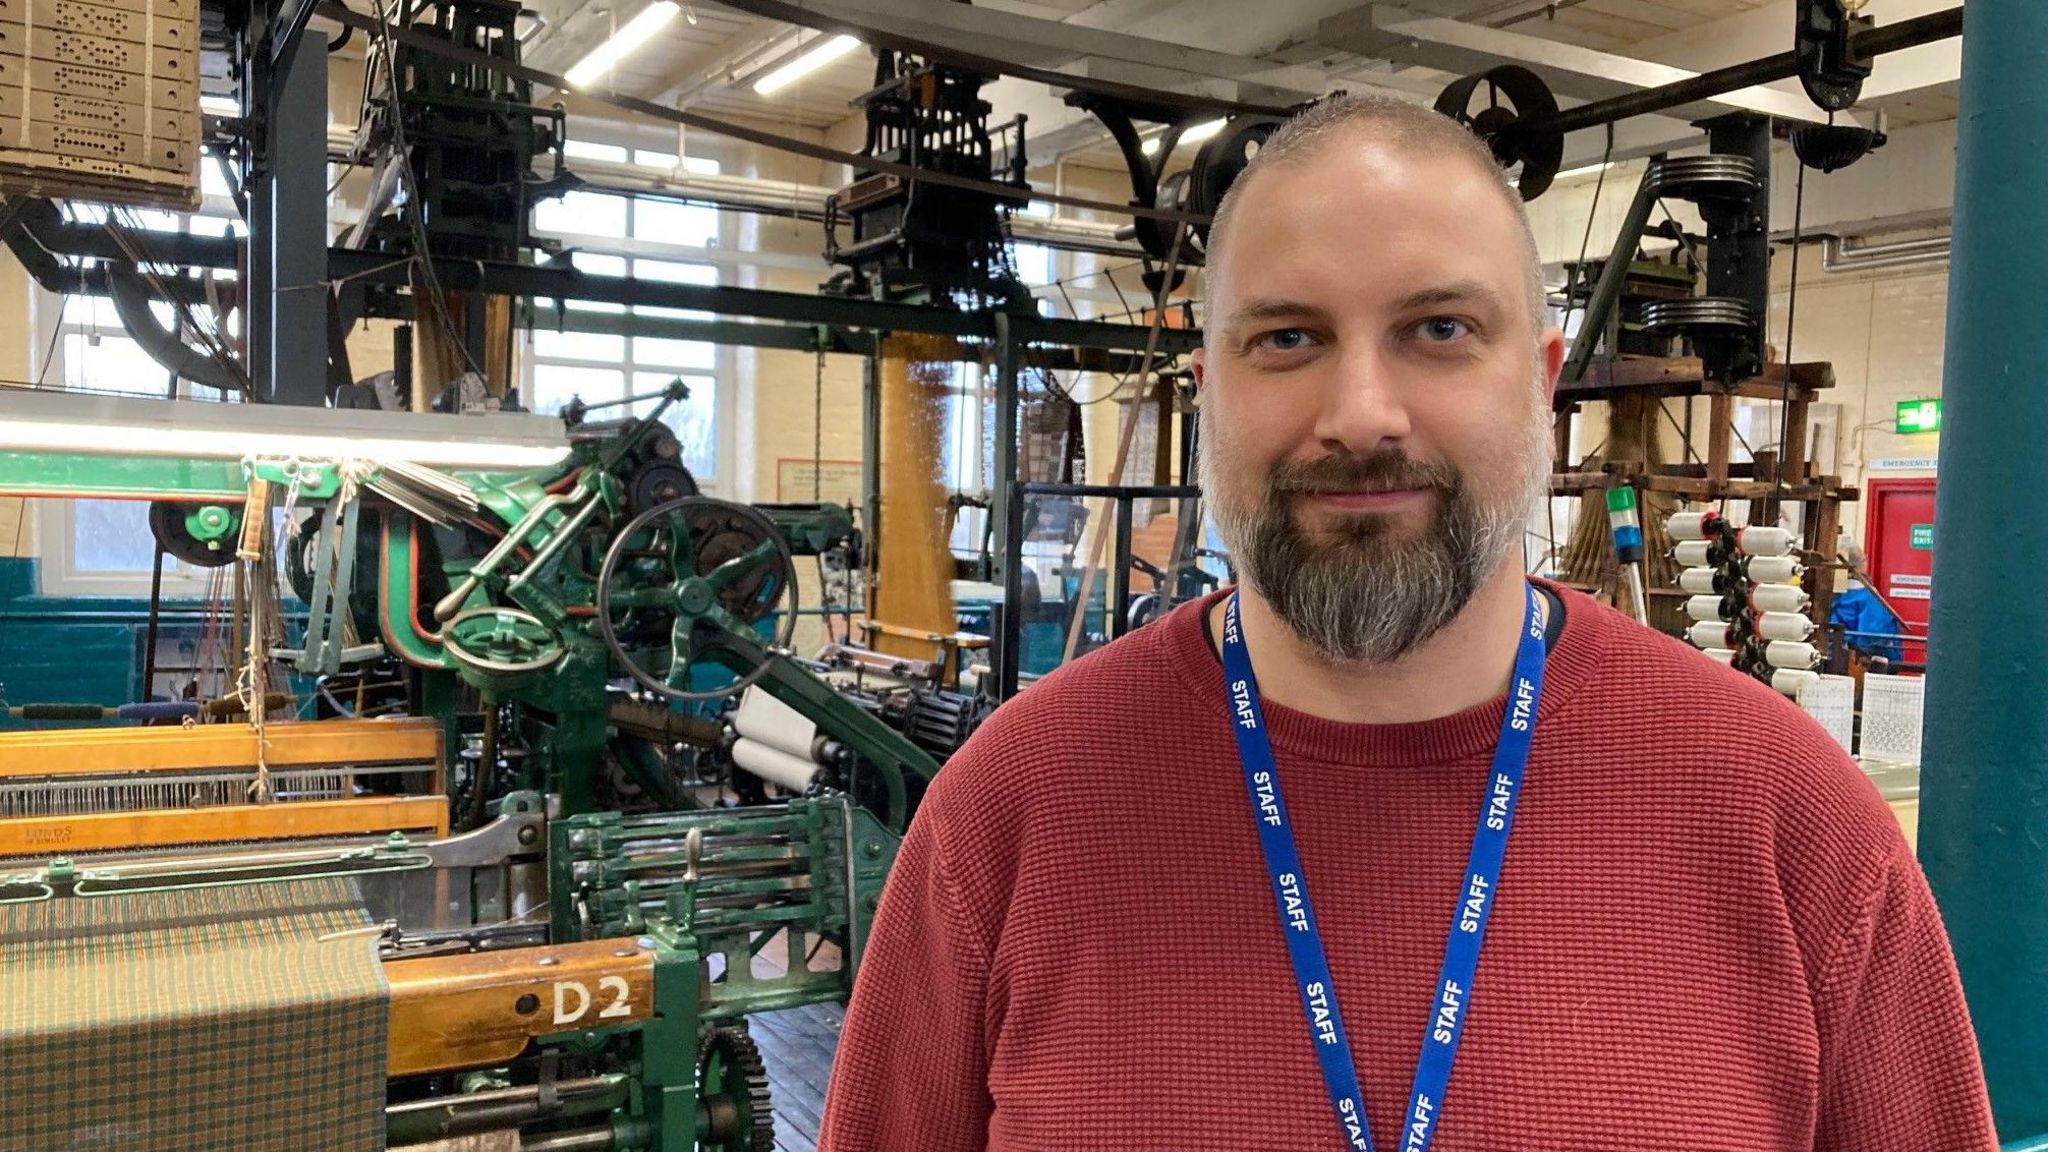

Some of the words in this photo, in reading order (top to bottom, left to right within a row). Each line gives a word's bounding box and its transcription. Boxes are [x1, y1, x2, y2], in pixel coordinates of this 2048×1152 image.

[1232, 679, 1257, 729] STAFF
[1511, 678, 1535, 731] STAFF
[1253, 771, 1282, 826] STAFF
[1486, 773, 1514, 831] STAFF
[1279, 873, 1309, 932] STAFF
[1459, 873, 1489, 933] STAFF
[1306, 981, 1338, 1045] STAFF
[1433, 979, 1464, 1044] STAFF
[1339, 1097, 1369, 1152] STAF
